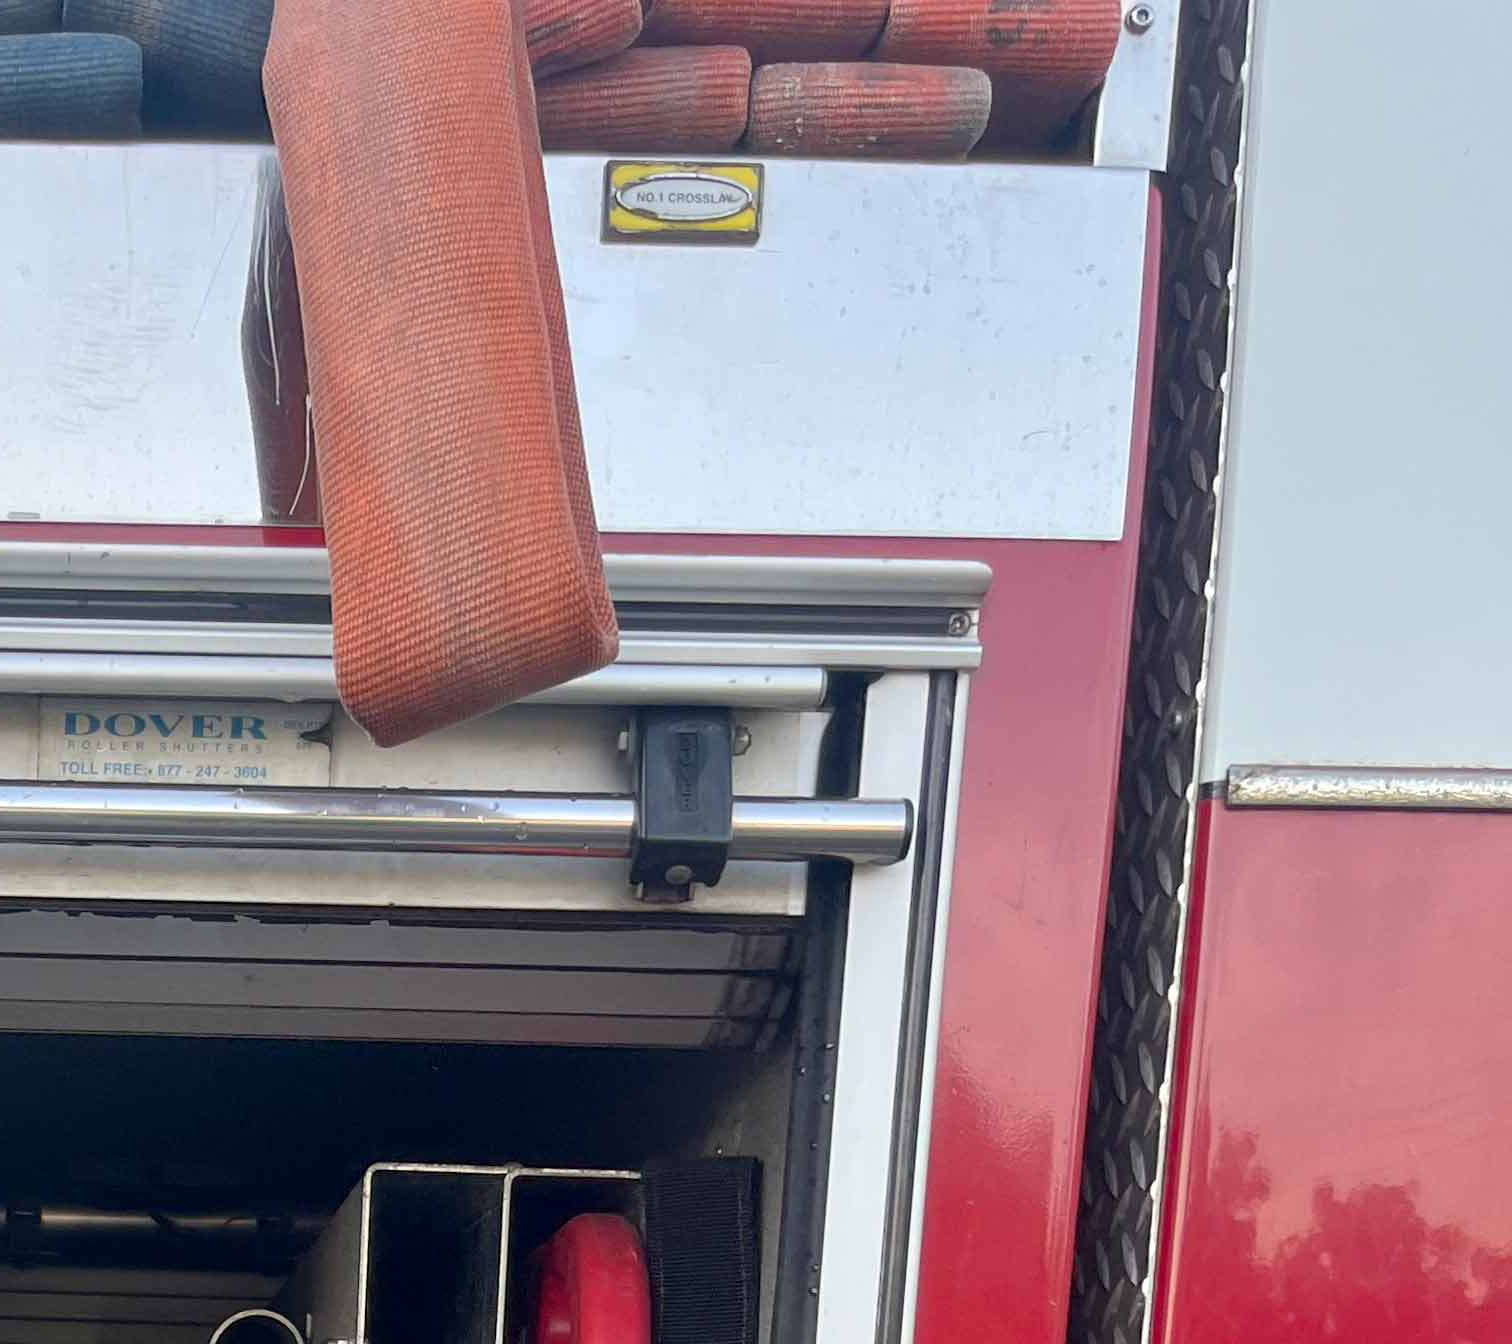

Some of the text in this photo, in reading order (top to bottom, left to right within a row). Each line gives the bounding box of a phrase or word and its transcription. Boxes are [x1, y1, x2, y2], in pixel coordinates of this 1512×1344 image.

[63, 711, 268, 741] DOVER
[67, 740, 264, 754] ROLLER SHUTTERS
[59, 761, 99, 775] TOLL
